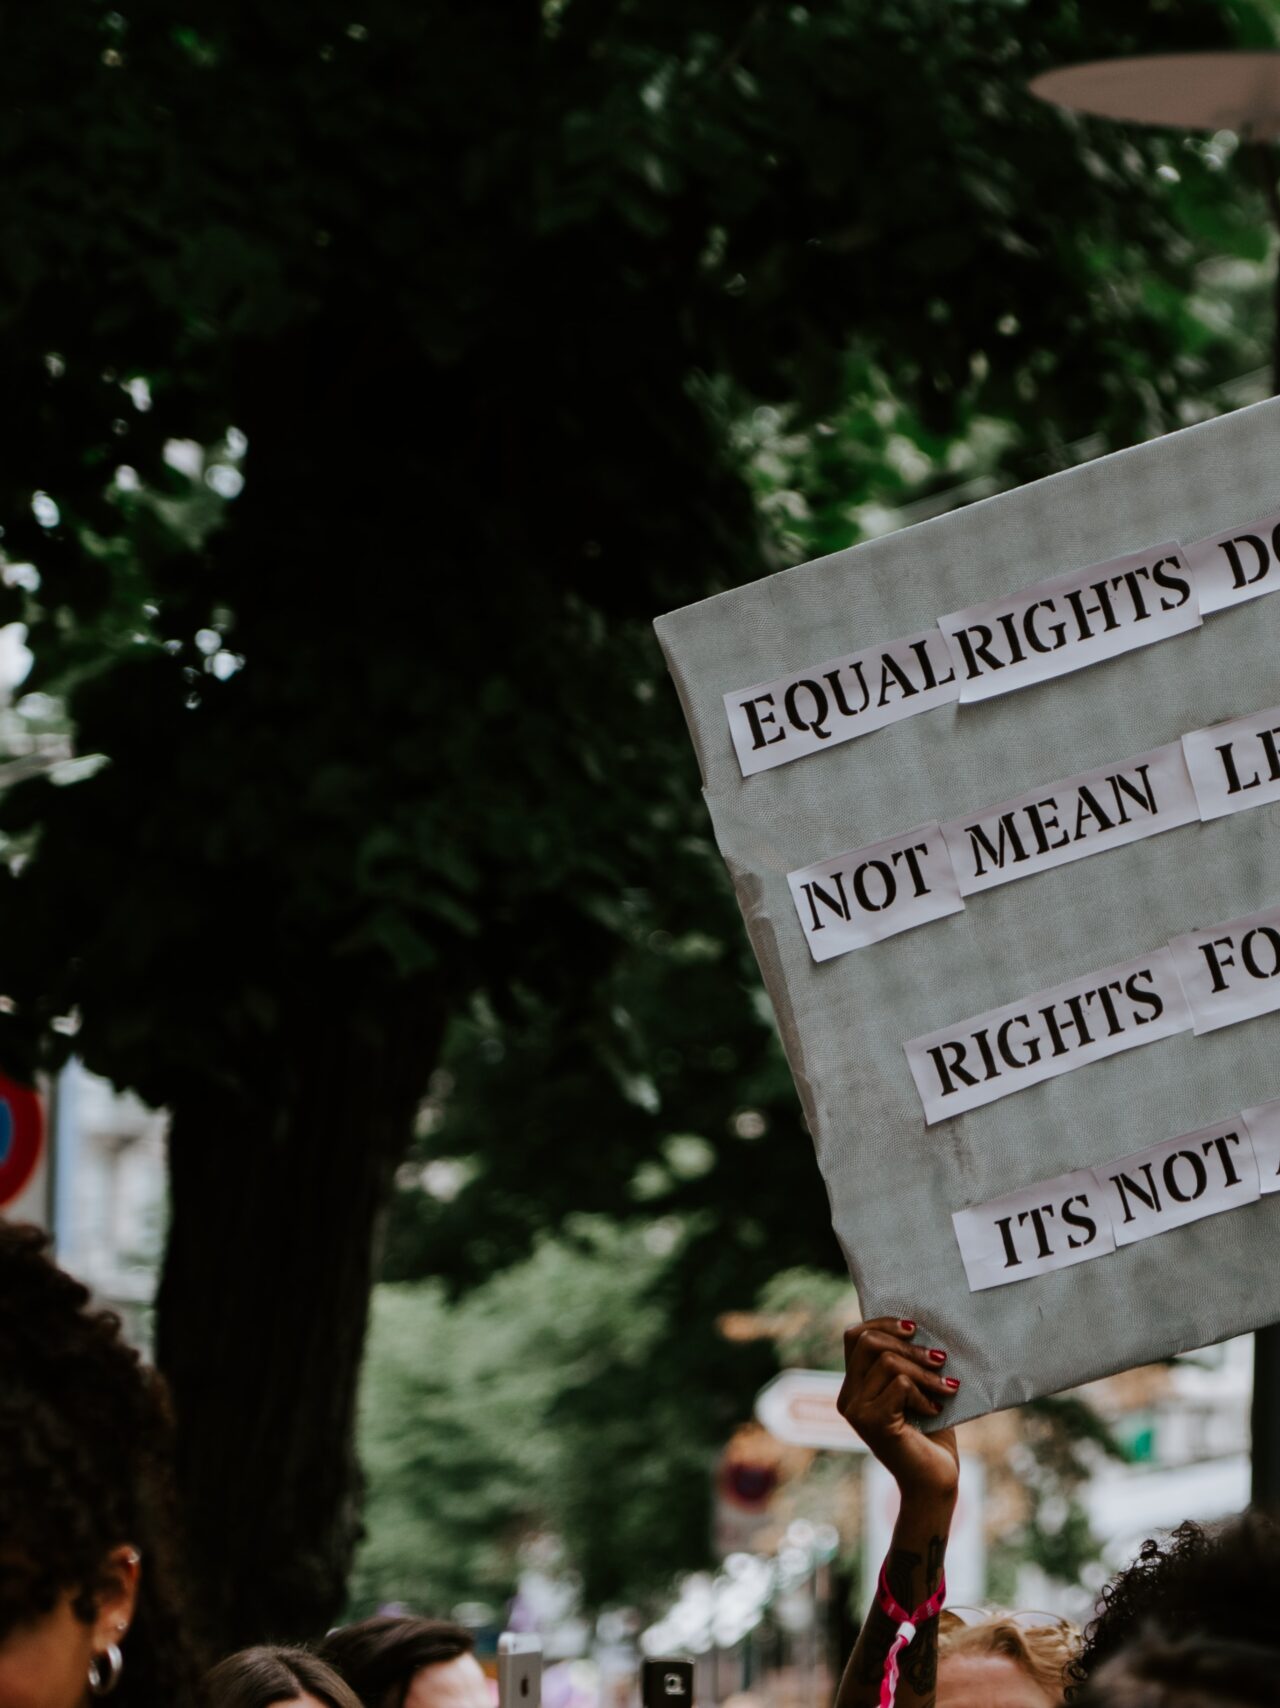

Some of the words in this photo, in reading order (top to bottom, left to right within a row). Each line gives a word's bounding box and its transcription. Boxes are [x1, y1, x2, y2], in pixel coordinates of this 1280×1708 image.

[740, 640, 955, 751] EQUAL
[952, 555, 1190, 679] RIGHTS
[800, 843, 929, 931] NOT
[964, 765, 1158, 877] MEAN
[926, 970, 1164, 1097] RIGHTS
[994, 1195, 1098, 1268] ITS
[1109, 1133, 1243, 1223] NOT
